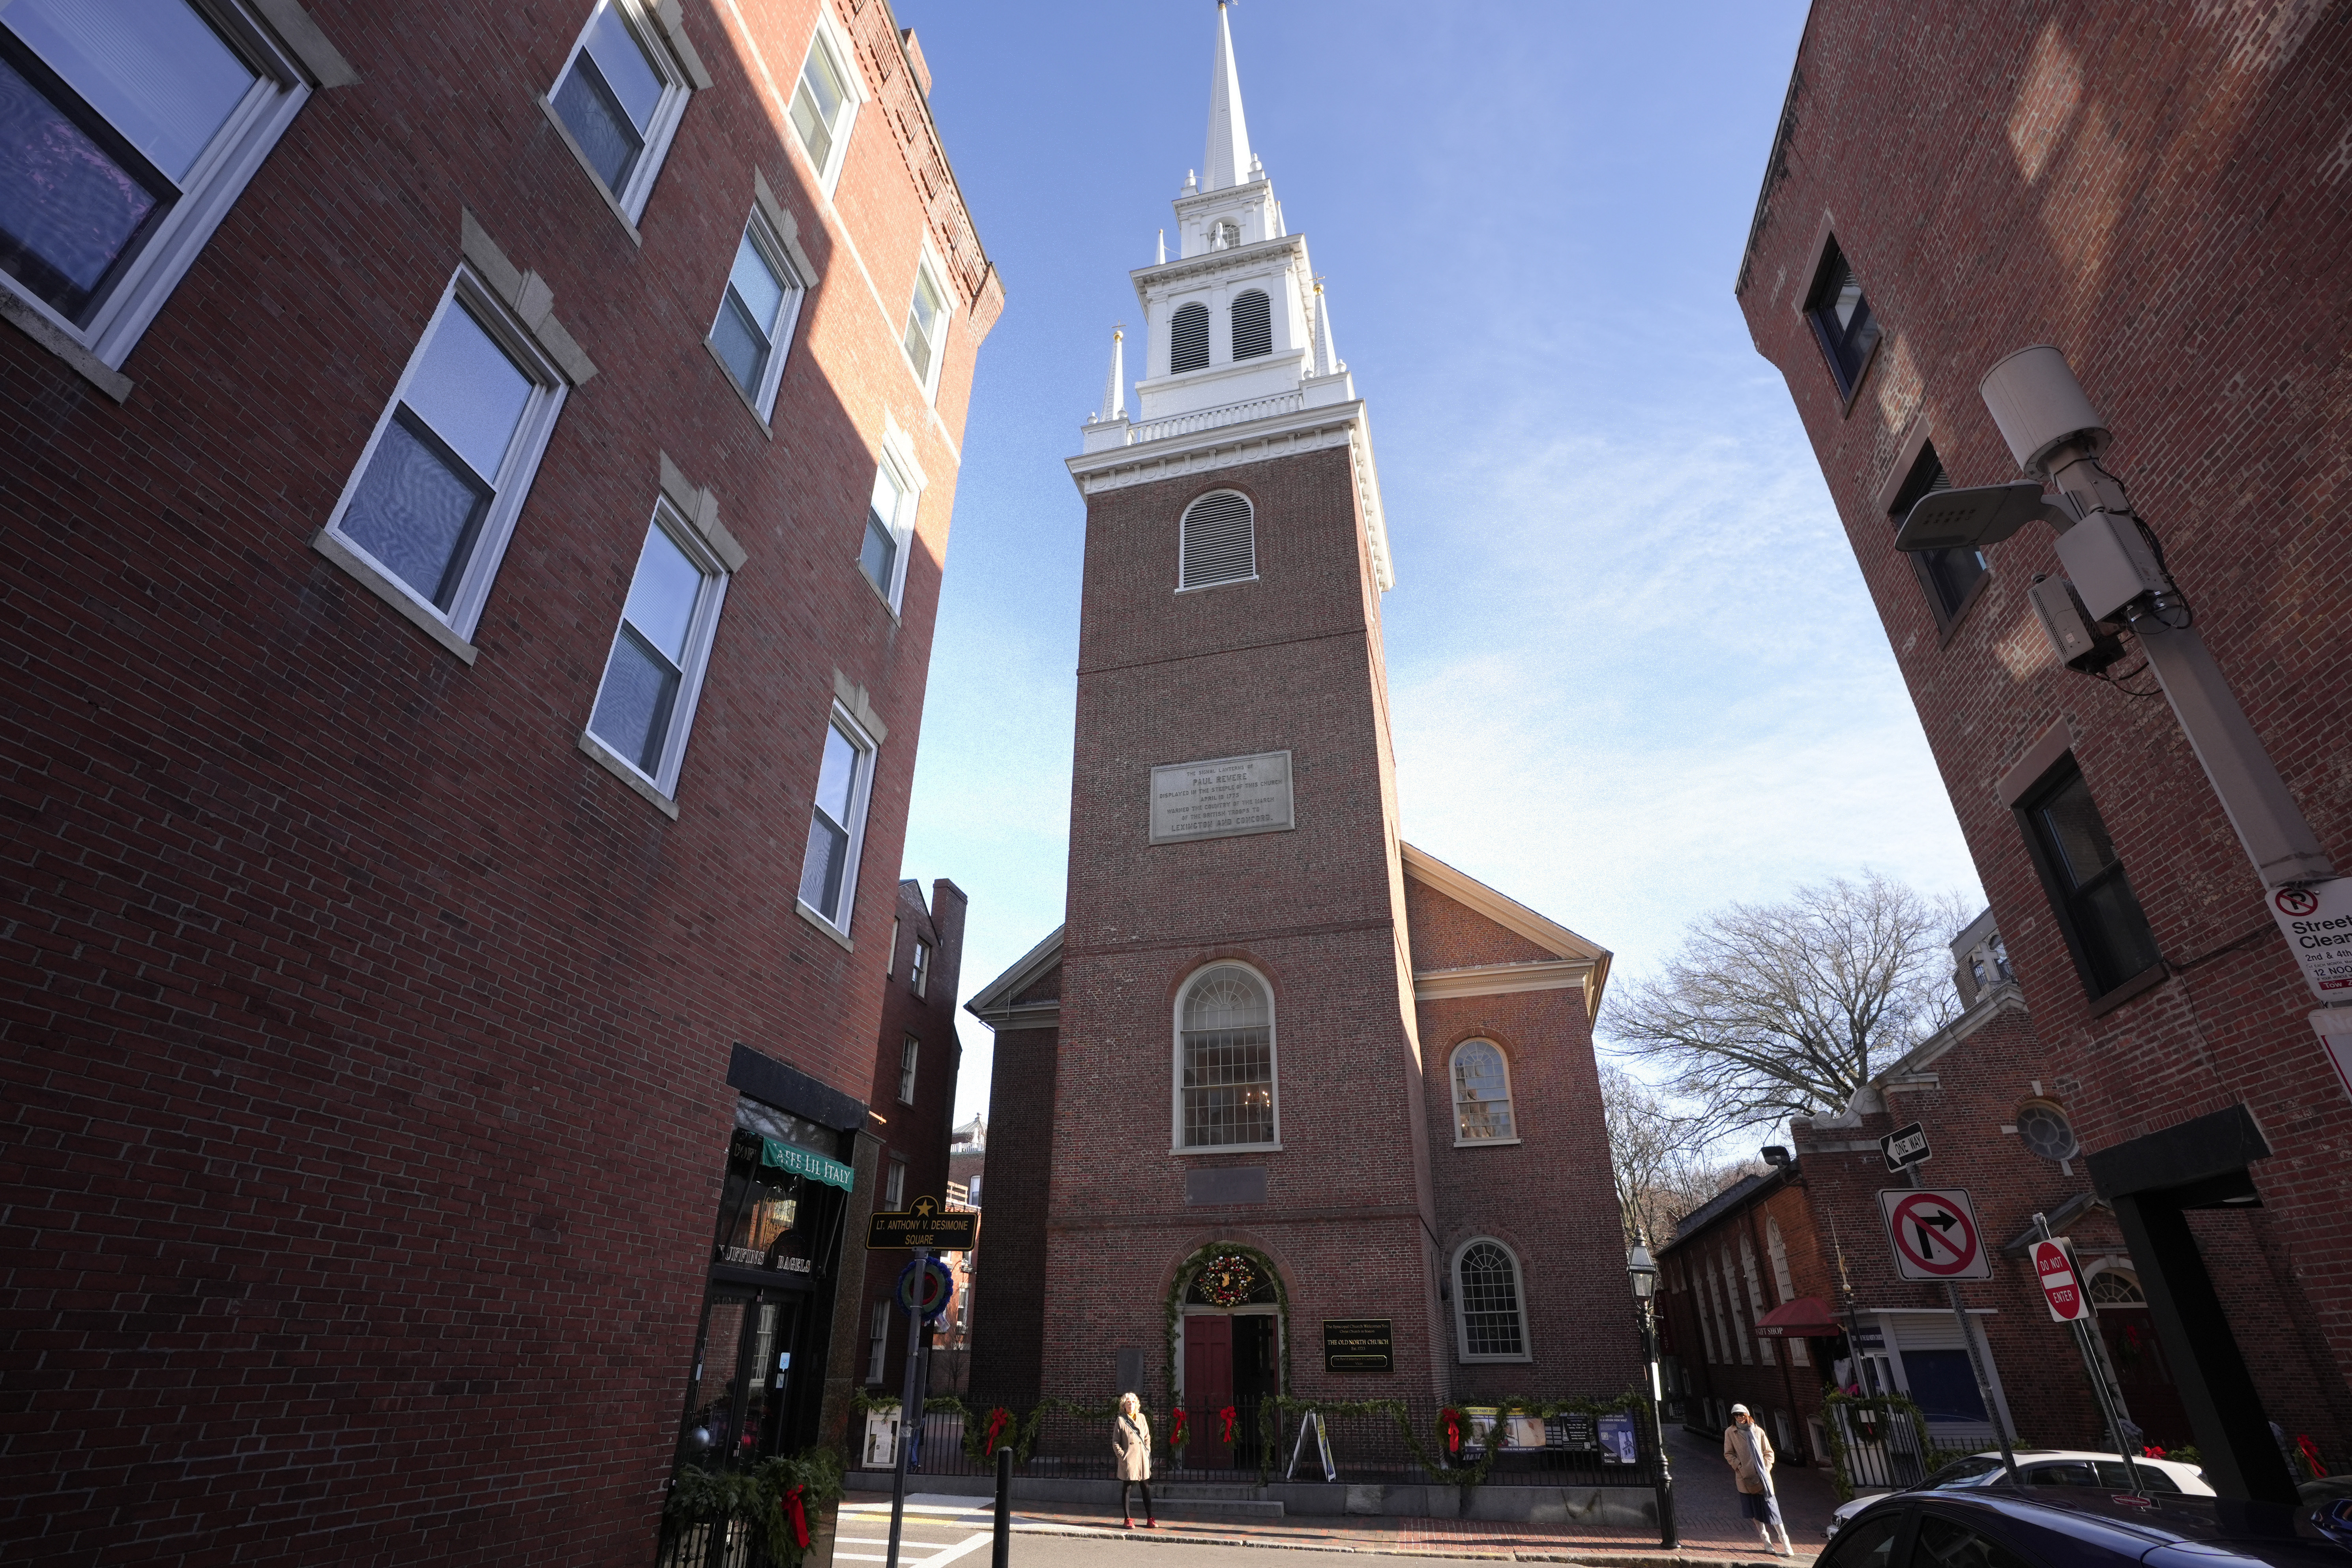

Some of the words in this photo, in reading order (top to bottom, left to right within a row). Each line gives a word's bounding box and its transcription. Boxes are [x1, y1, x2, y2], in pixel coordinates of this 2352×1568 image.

[1193, 777, 1212, 786] PAUL
[1216, 773, 1247, 783] REVERE
[1172, 821, 1212, 832] LEXINGTON
[1236, 815, 1273, 824] CONCORD.
[2292, 915, 2352, 934] Street
[2305, 953, 2323, 961] 2nd
[2328, 965, 2352, 974] NOO
[1895, 1140, 1908, 1156] ONE
[1908, 1134, 1922, 1150] WAY
[773, 1143, 801, 1169] AFFE
[824, 1161, 850, 1184] ITALY
[876, 1220, 885, 1230] LT.
[887, 1220, 921, 1230] ANTHONY
[923, 1220, 928, 1230] V.
[931, 1220, 969, 1230] DESIMONE
[905, 1235, 934, 1245] SQUARE
[777, 1255, 811, 1273] BAGELS
[2039, 1260, 2049, 1271] DO
[2050, 1256, 2063, 1269] NOT
[2052, 1290, 2074, 1303] ENTER
